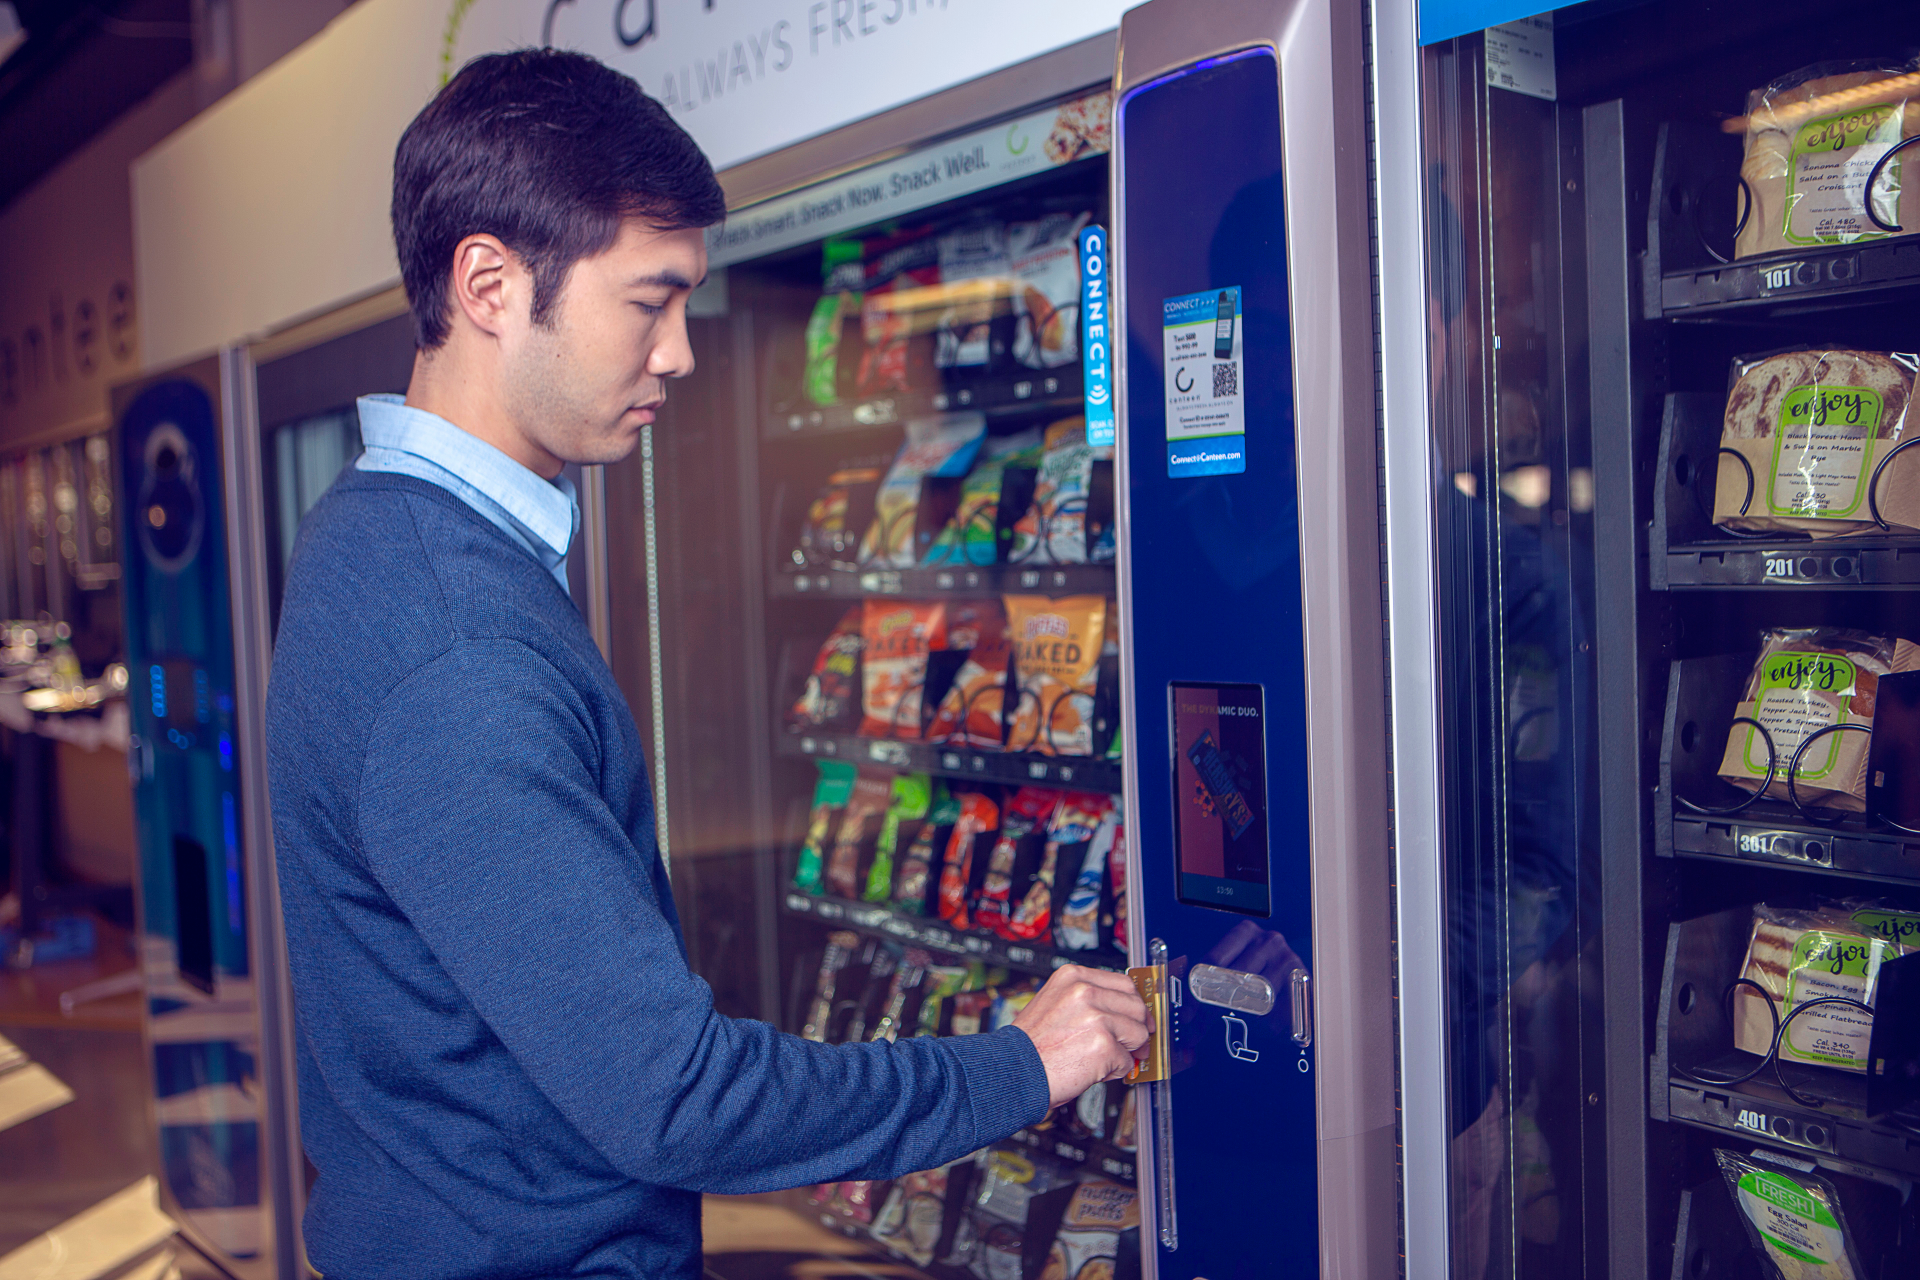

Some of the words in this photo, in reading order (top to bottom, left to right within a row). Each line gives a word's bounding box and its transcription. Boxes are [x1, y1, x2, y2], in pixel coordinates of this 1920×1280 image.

[661, 20, 794, 114] ALWAYS
[1804, 111, 1891, 151] enjoy
[888, 161, 942, 198] Snack
[943, 145, 990, 179] Well.
[1803, 163, 1840, 171] Sonoma
[1842, 159, 1878, 168] Chicke
[1799, 174, 1824, 183] Salad
[1817, 183, 1862, 191] Croissant
[1819, 218, 1835, 226] Cal.
[1764, 268, 1791, 290] 101
[1086, 234, 1105, 380] CONNECT
[1164, 298, 1200, 313] CONNECT
[1169, 394, 1201, 405] canteen
[1789, 389, 1872, 427] enjoy
[1811, 454, 1827, 462] Rye
[1765, 557, 1793, 576] 201
[1771, 658, 1846, 690] enjoy
[1182, 703, 1198, 714] THE
[1199, 704, 1237, 716] DYNAMIC
[1762, 707, 1788, 715] Pepper
[1813, 710, 1832, 718] Red
[1760, 716, 1785, 724] Pepper
[1773, 727, 1801, 735] Pretzel
[1740, 834, 1767, 854] 301
[1873, 917, 1920, 943] njo
[1805, 989, 1840, 999] Smoked
[1809, 979, 1840, 990] Bacon,
[1841, 985, 1859, 994] Egg
[1818, 1002, 1854, 1013] Spinach
[1815, 1038, 1829, 1047] Cal.
[1832, 1041, 1850, 1050] 340
[1738, 1109, 1767, 1132] 401
[1761, 1181, 1809, 1213] FRESH
[1767, 1205, 1784, 1220] Egg
[1785, 1214, 1809, 1230] Salad
